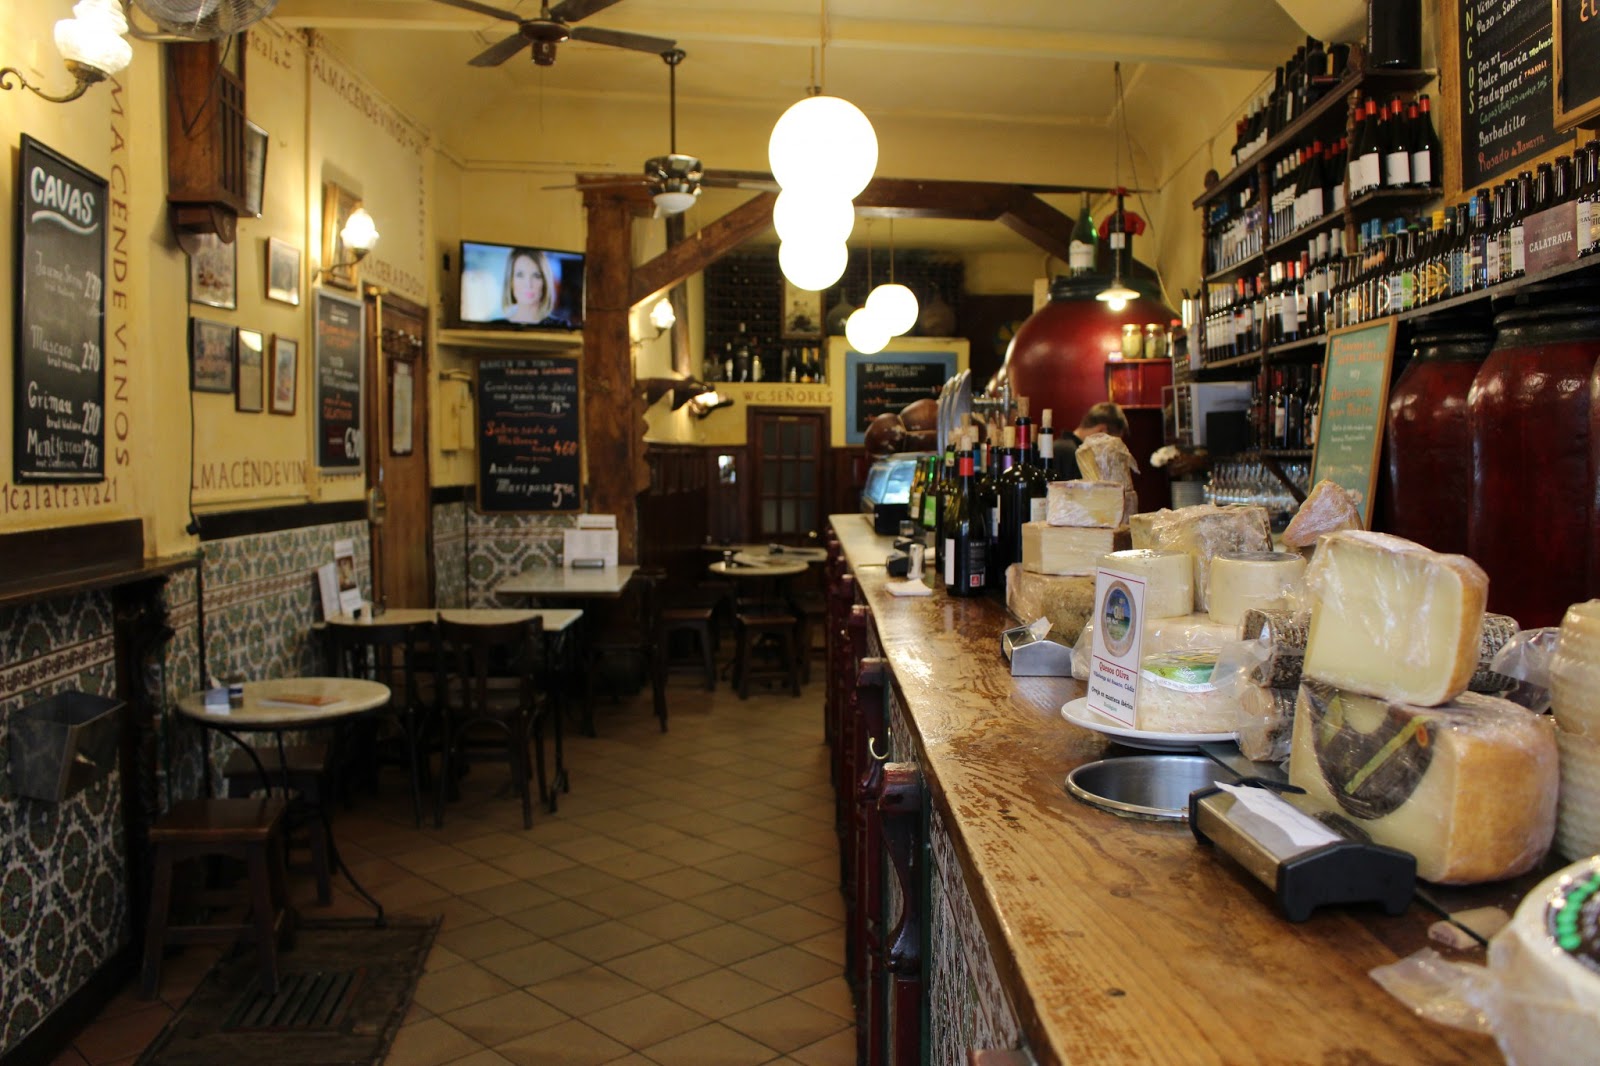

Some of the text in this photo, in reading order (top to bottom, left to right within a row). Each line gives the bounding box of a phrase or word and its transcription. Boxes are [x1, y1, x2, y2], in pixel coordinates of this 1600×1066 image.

[1478, 71, 1499, 92] Dulce
[1478, 114, 1527, 148] Barbadillo
[31, 166, 96, 225] CAVAS
[1529, 230, 1573, 253] CALATRAVA
[28, 380, 73, 415] Grimau
